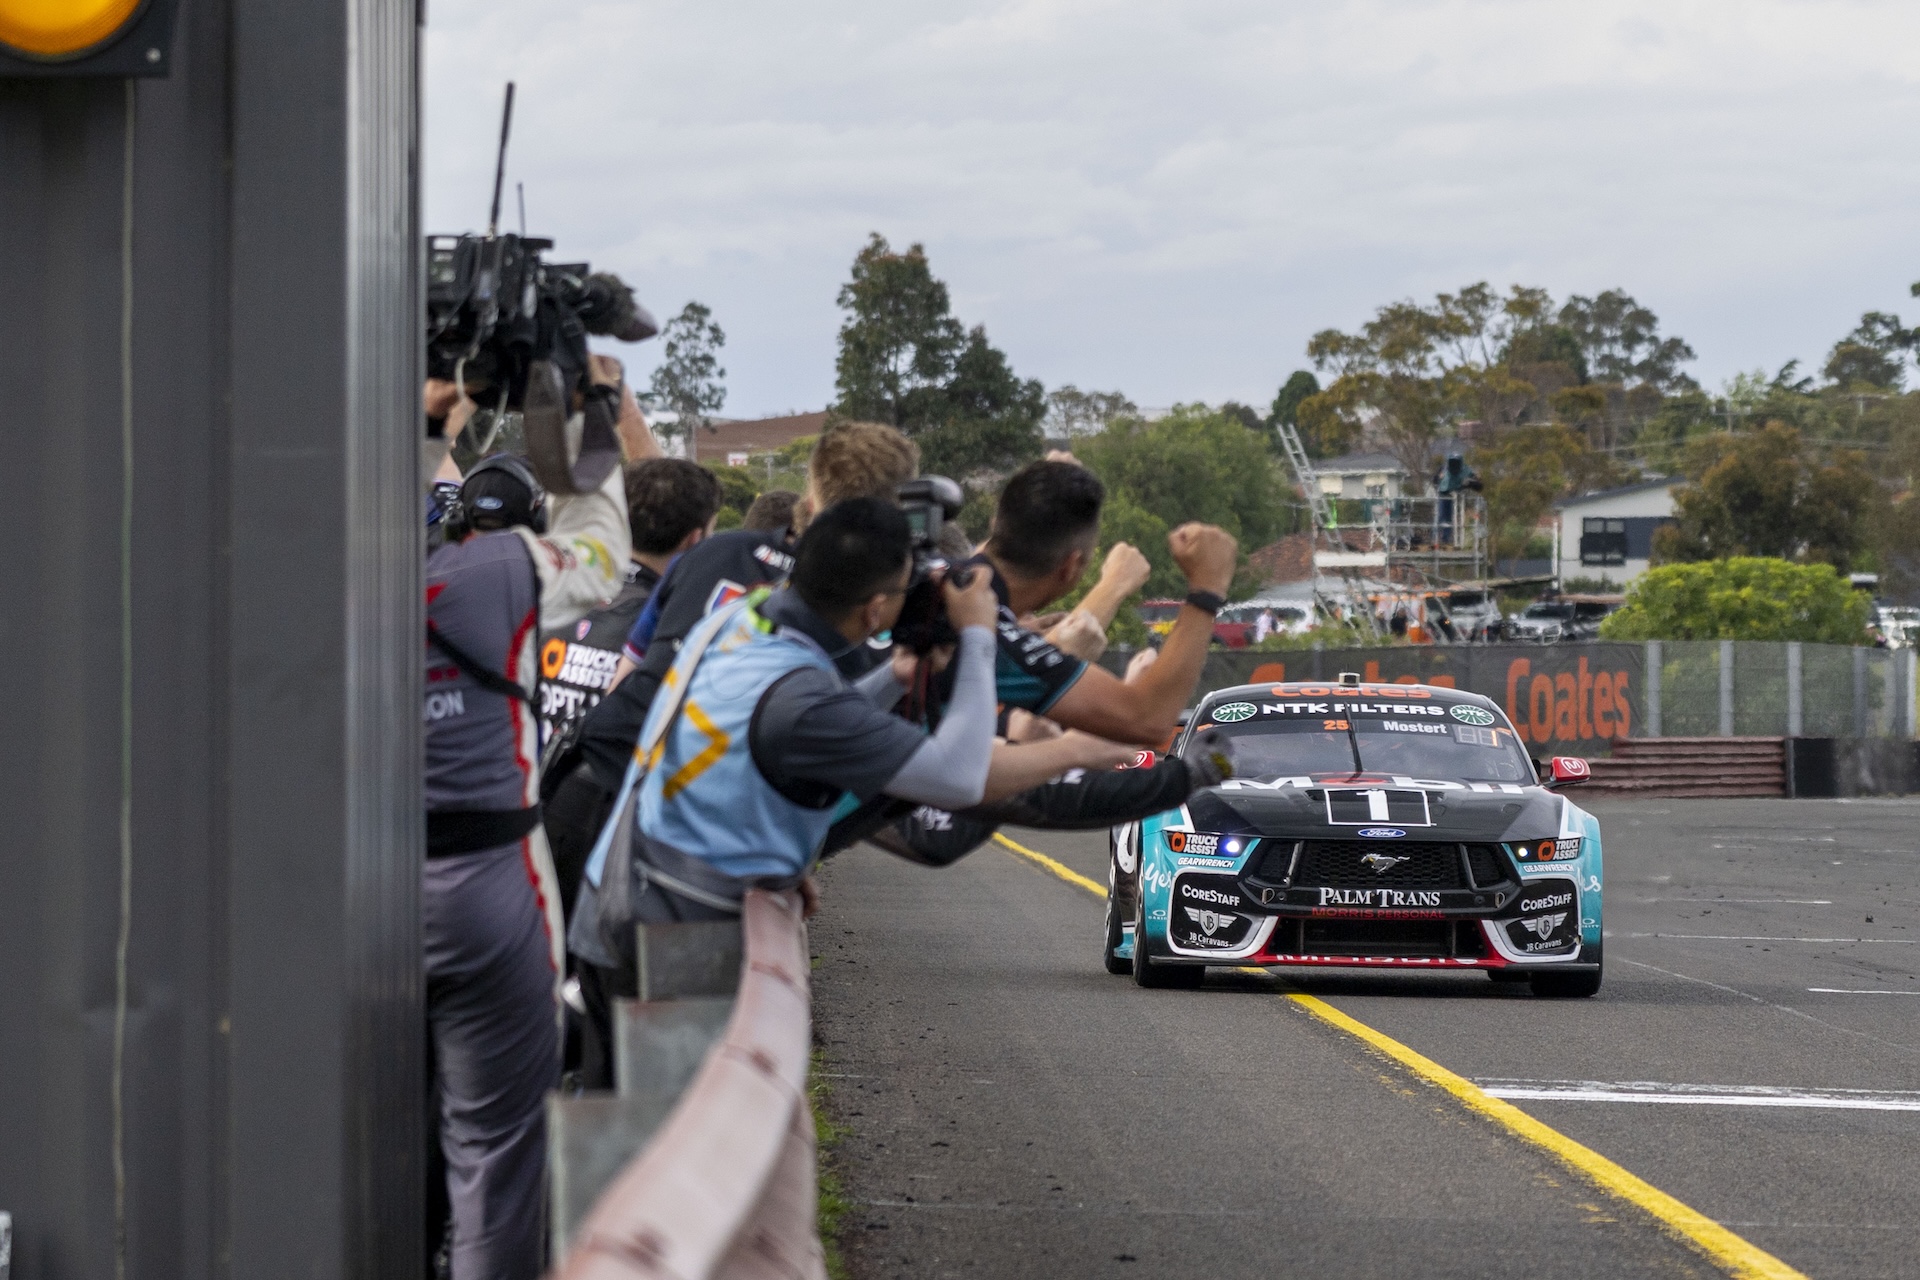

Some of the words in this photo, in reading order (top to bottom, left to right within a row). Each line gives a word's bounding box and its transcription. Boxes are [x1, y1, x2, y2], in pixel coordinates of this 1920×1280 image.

[565, 642, 621, 672] TRUCK
[558, 664, 616, 690] ASSIST
[1271, 686, 1432, 699] Coates
[1507, 656, 1632, 744] Coates
[1263, 703, 1329, 714] NTK
[1334, 702, 1446, 716] FILTERS
[1323, 719, 1349, 731] 25
[1383, 720, 1447, 734] Mostert
[1356, 789, 1390, 821] 1
[1186, 834, 1219, 846] TRUCK
[1555, 839, 1579, 851] TRUCK
[1183, 845, 1217, 856] ASSIST
[1553, 848, 1578, 861] ASSIST
[1177, 857, 1235, 869] GEARWRENCH
[1523, 863, 1575, 873] GEARWRENCH
[1319, 887, 1372, 907] PALM
[1376, 889, 1441, 908] TRANS
[1311, 907, 1374, 918] MORRIS
[1377, 909, 1446, 919] PERSONAL
[1189, 932, 1197, 942] JB
[1198, 933, 1229, 947] Caravans
[1526, 942, 1534, 953] JB
[1535, 938, 1562, 951] Caravans
